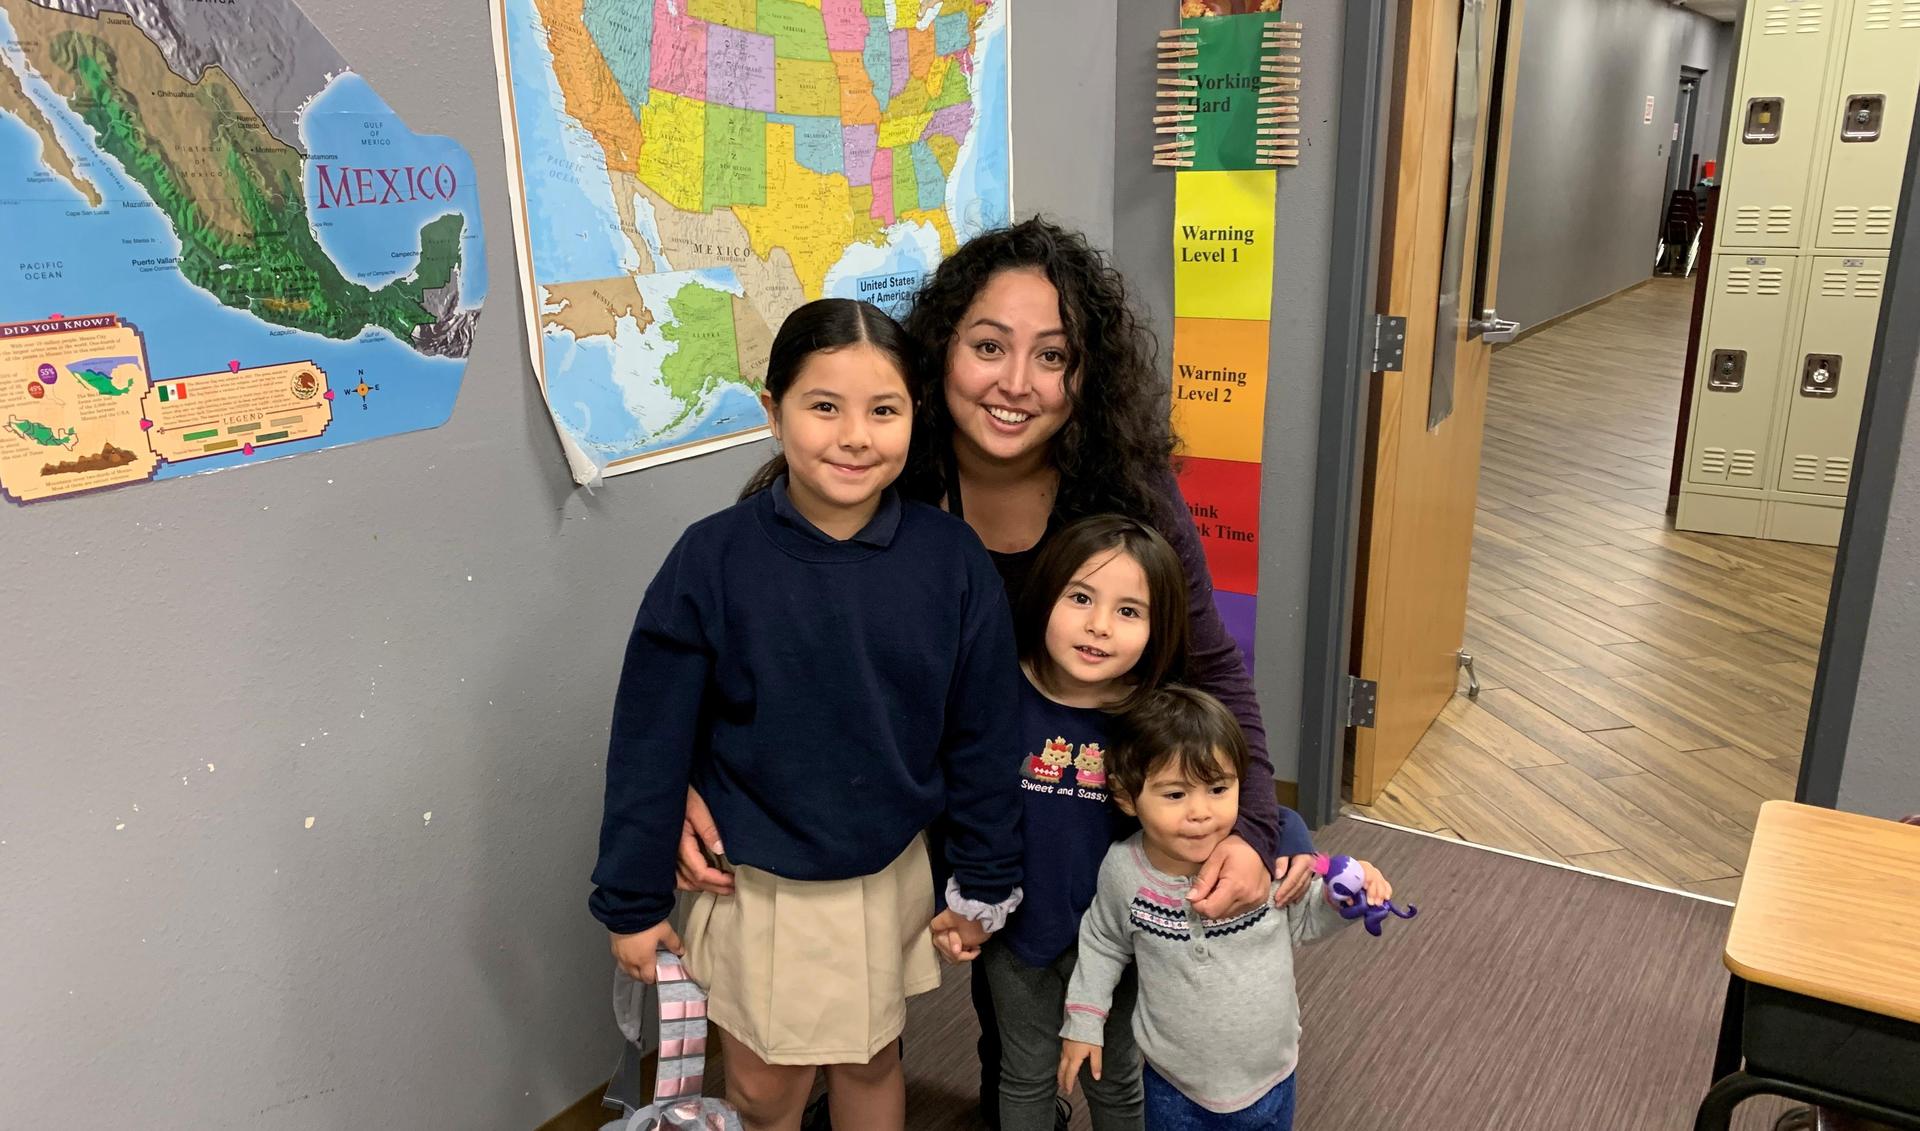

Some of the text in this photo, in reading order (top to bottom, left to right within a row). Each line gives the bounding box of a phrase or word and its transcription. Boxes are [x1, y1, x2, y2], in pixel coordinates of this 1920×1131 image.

[1188, 72, 1260, 93] Working
[547, 155, 586, 173] PACIFIC
[549, 169, 581, 185] OCEAN
[316, 163, 457, 209] MEXICO
[1182, 225, 1254, 245] Warning
[693, 243, 751, 258] MEXICO
[1182, 247, 1239, 263] Level 1
[20, 261, 63, 271] PACIFIC
[24, 272, 62, 281] OCEAN
[860, 277, 915, 292] United States
[866, 290, 911, 304] of America
[4, 317, 110, 336] DID YOU KNOW?
[40, 368, 54, 376] 55%
[1178, 365, 1247, 387] Warning
[1178, 385, 1232, 403] Level 2
[362, 403, 368, 411] S
[223, 412, 264, 425] LEGEND
[1186, 502, 1218, 519] hink
[1215, 524, 1254, 542] Time
[1021, 779, 1108, 802] Sweet and Sassy
